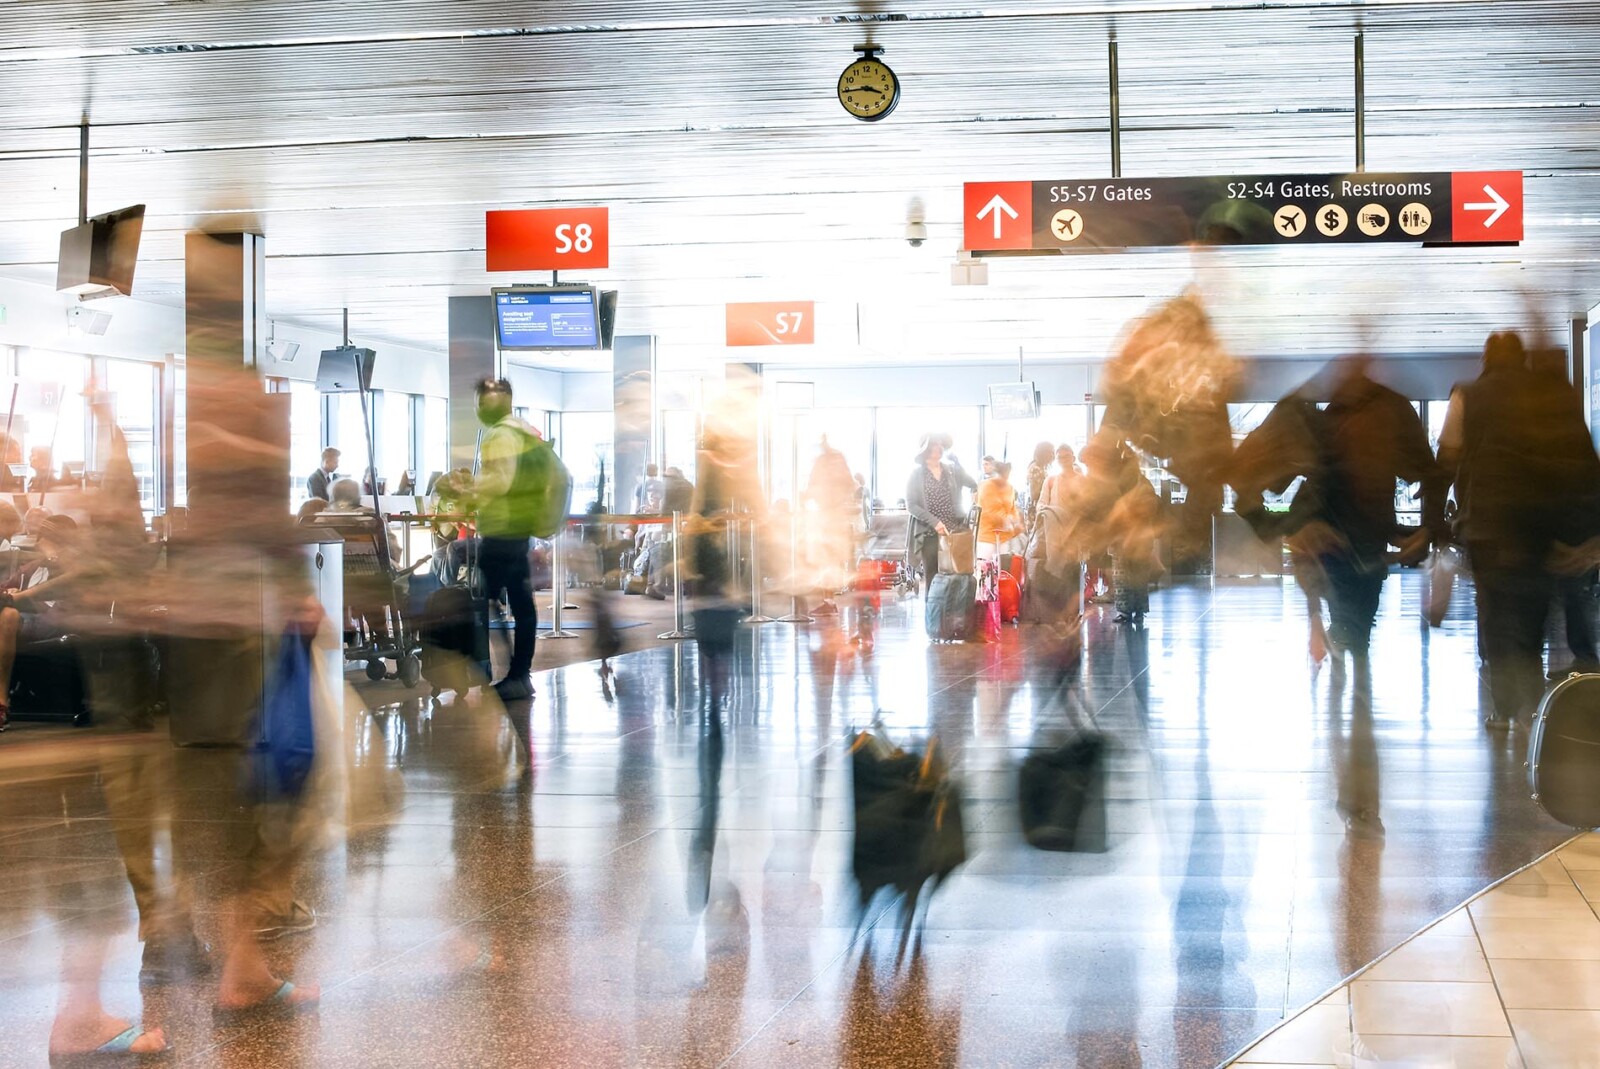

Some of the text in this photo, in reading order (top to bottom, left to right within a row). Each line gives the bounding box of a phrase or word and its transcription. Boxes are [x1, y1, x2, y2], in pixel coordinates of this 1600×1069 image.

[1050, 185, 1152, 202] S5-S7 Gates
[1227, 180, 1432, 199] S2-S4 Gates, Restrooms
[555, 223, 593, 254] S8
[776, 311, 803, 334] S7
